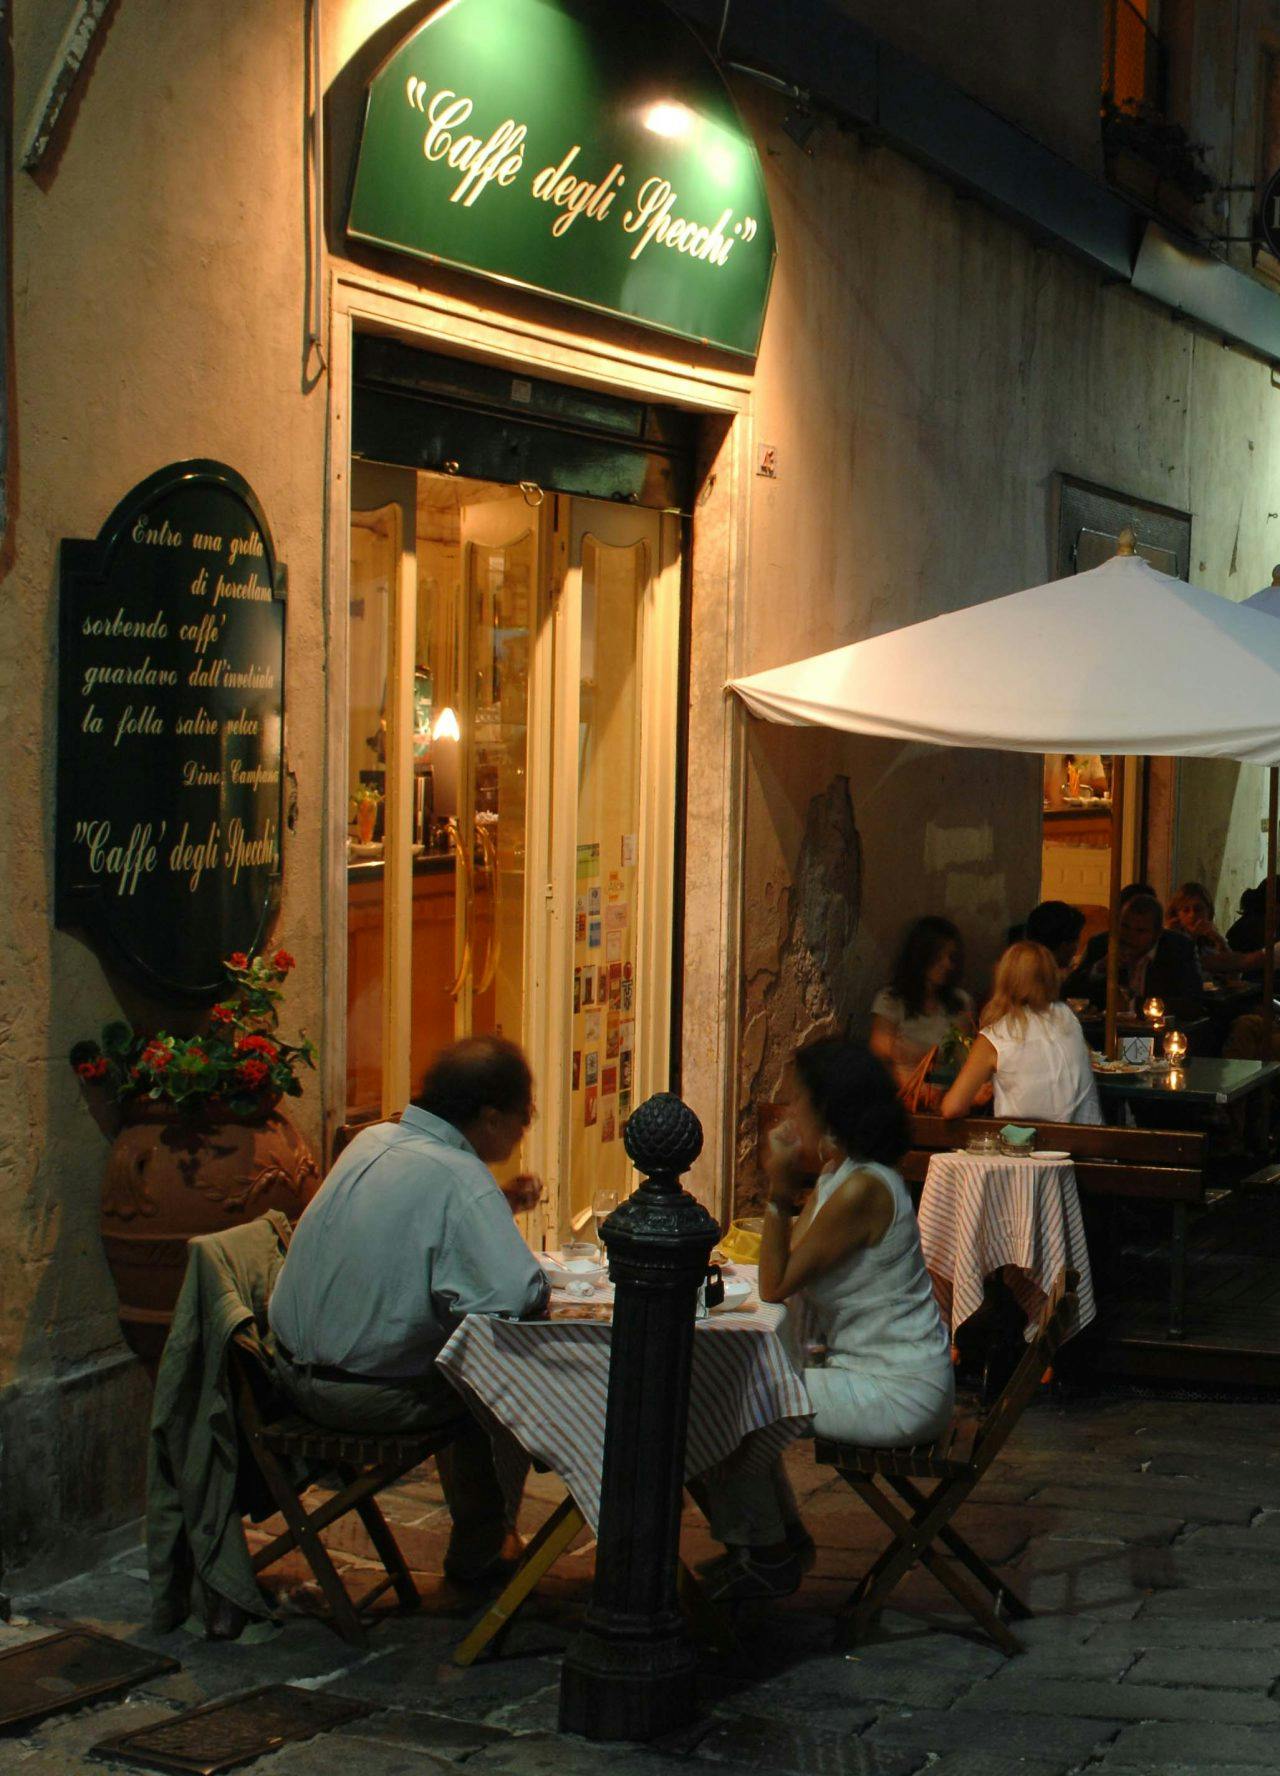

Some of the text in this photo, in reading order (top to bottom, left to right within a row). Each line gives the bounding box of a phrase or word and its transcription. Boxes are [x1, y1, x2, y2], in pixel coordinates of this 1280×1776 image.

[533, 146, 625, 237] degli
[132, 513, 183, 547] Entro
[192, 533, 222, 551] una
[191, 567, 209, 596] di
[82, 607, 168, 639] sorbendo
[81, 656, 178, 696] guardavo
[81, 704, 104, 734] la
[113, 704, 164, 747] folla
[175, 705, 218, 735] salire
[169, 822, 221, 893] degli
